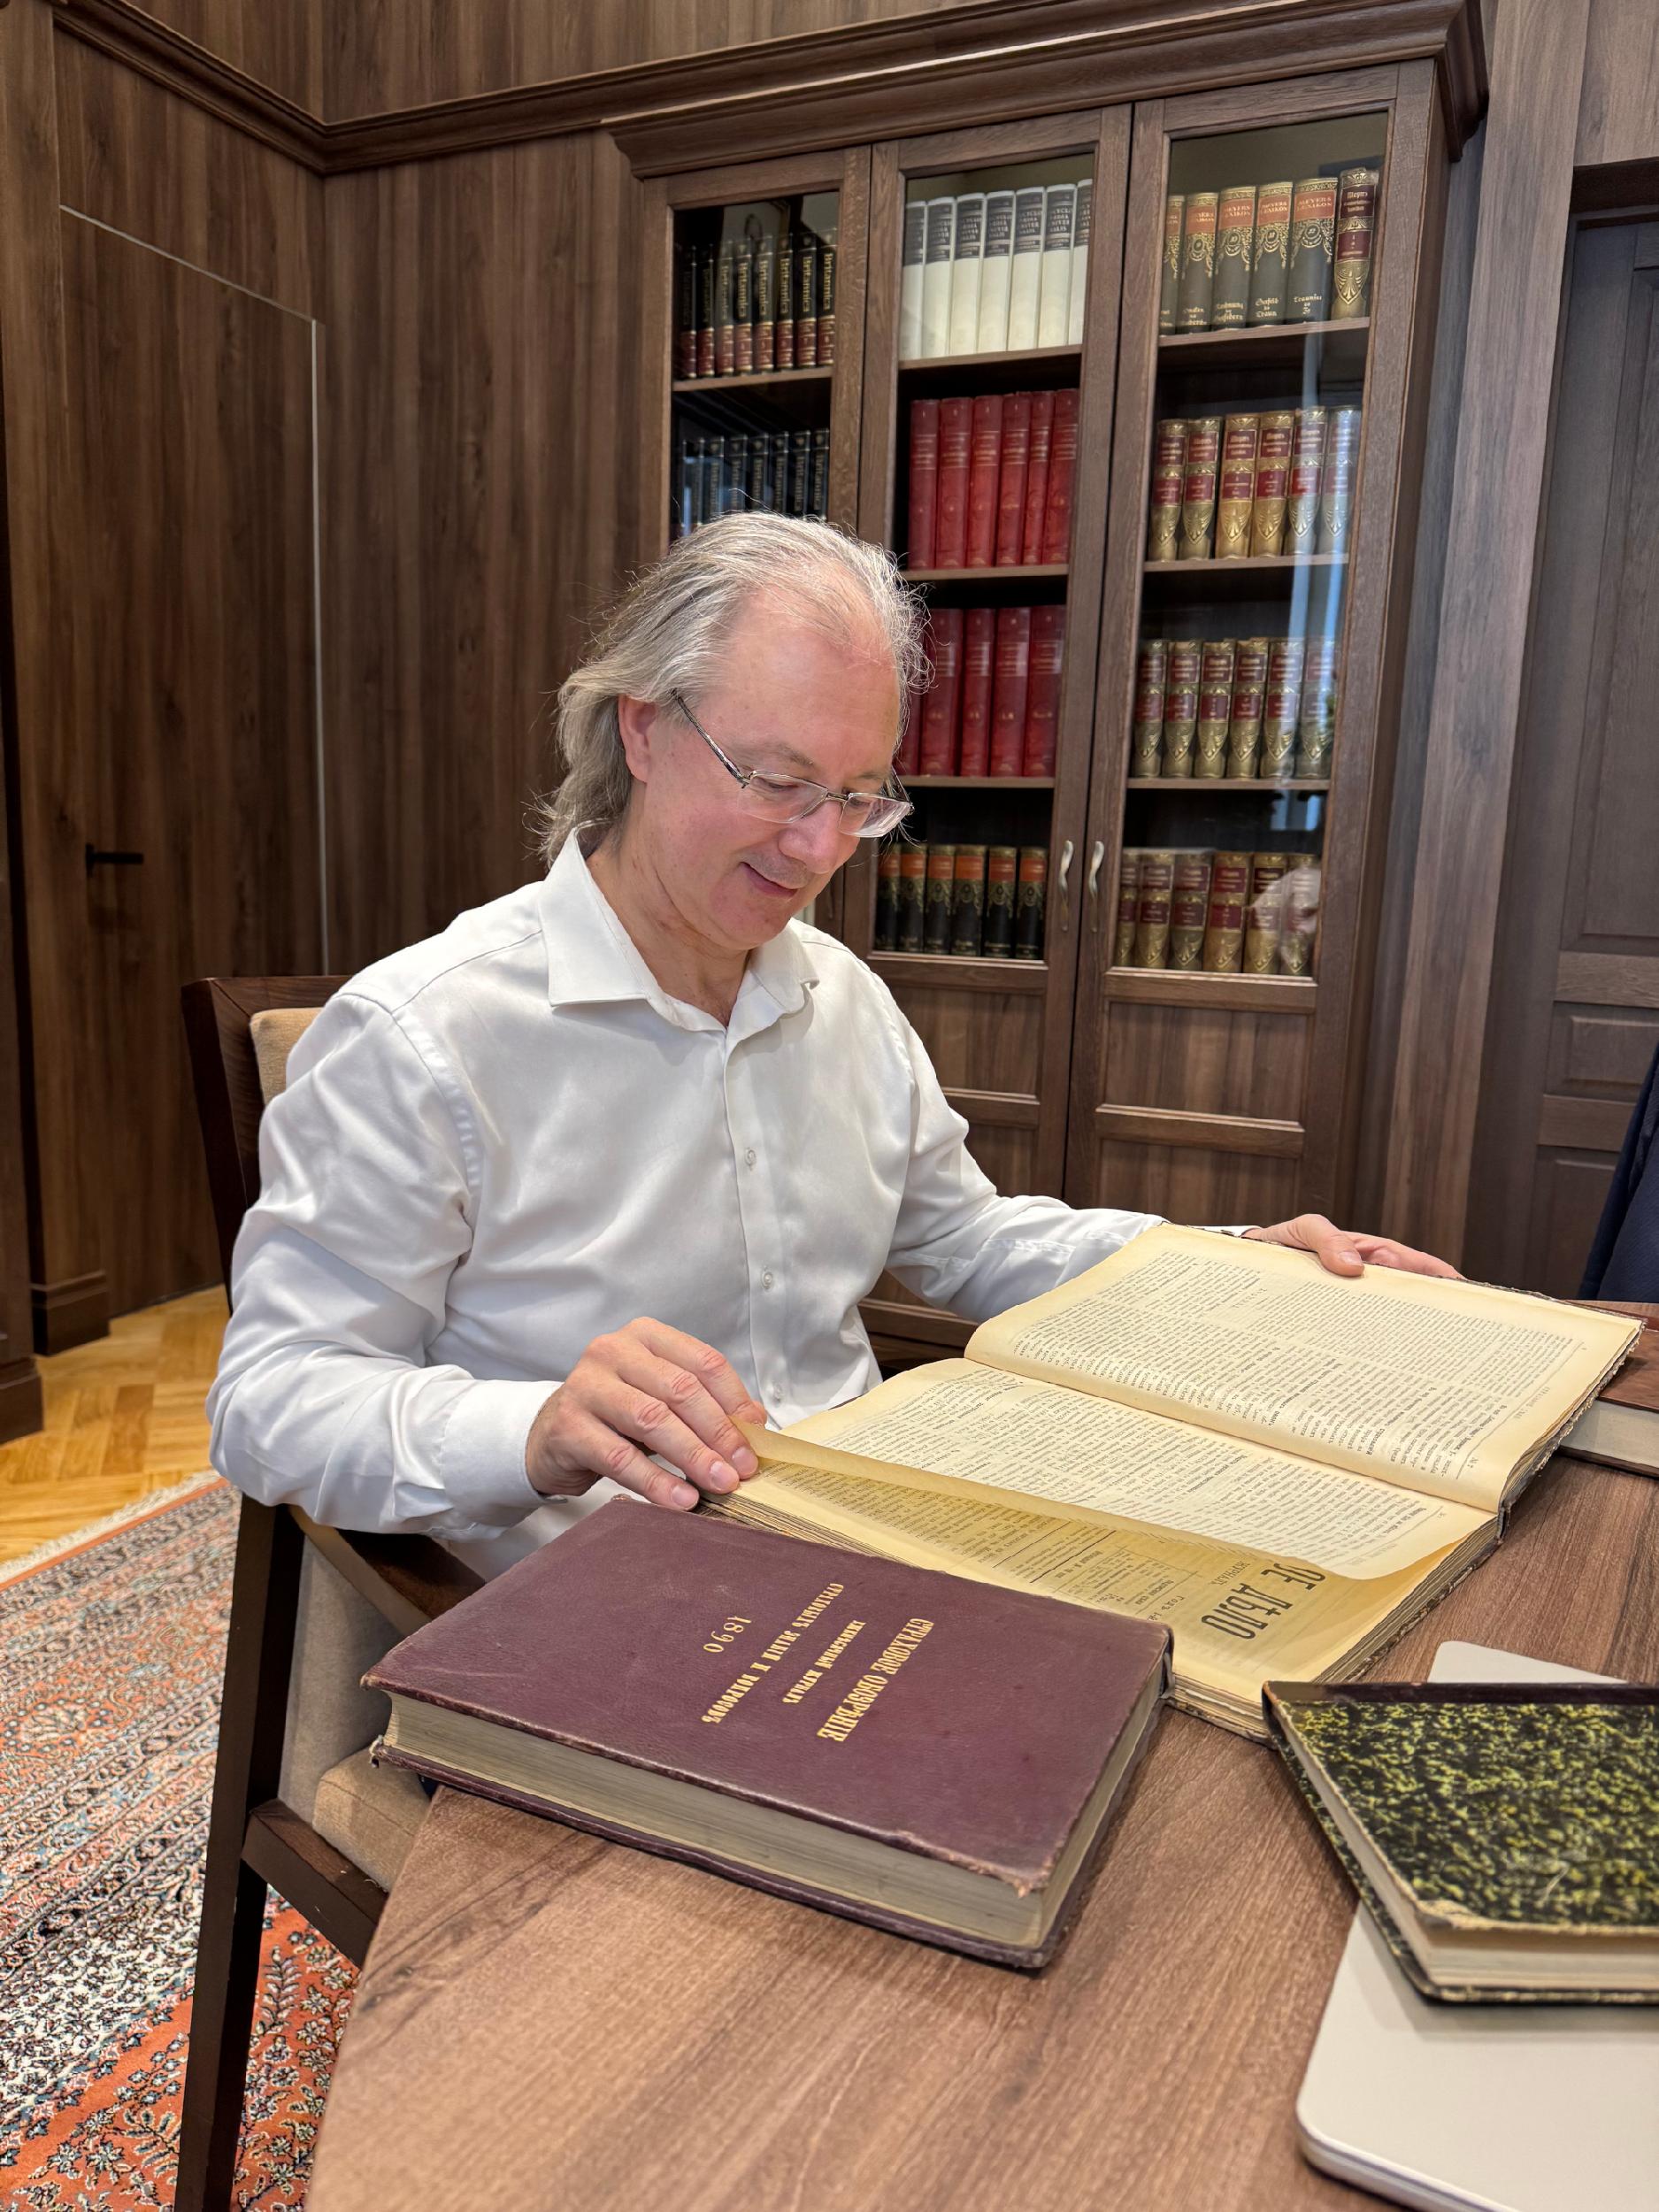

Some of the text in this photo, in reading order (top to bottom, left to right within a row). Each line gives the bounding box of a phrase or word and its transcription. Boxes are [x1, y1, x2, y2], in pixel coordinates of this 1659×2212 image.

[758, 259, 769, 316] Britannica
[780, 257, 790, 314] Britannica
[802, 256, 813, 312] Britannica
[823, 253, 833, 311] Britannica
[791, 1582, 845, 1629] СТРАХОВЫХЪ
[1201, 1582, 1293, 1640] ДѢЛО
[703, 1615, 752, 1654] 1890
[749, 1661, 772, 1672] И
[781, 1669, 823, 1705] ЖУРНАЛЪ
[816, 1617, 934, 1743] СТРАХОВОЕ ОБОЗРѢНІЕ
[700, 1673, 761, 1724] ВОПРОСОВЪ
